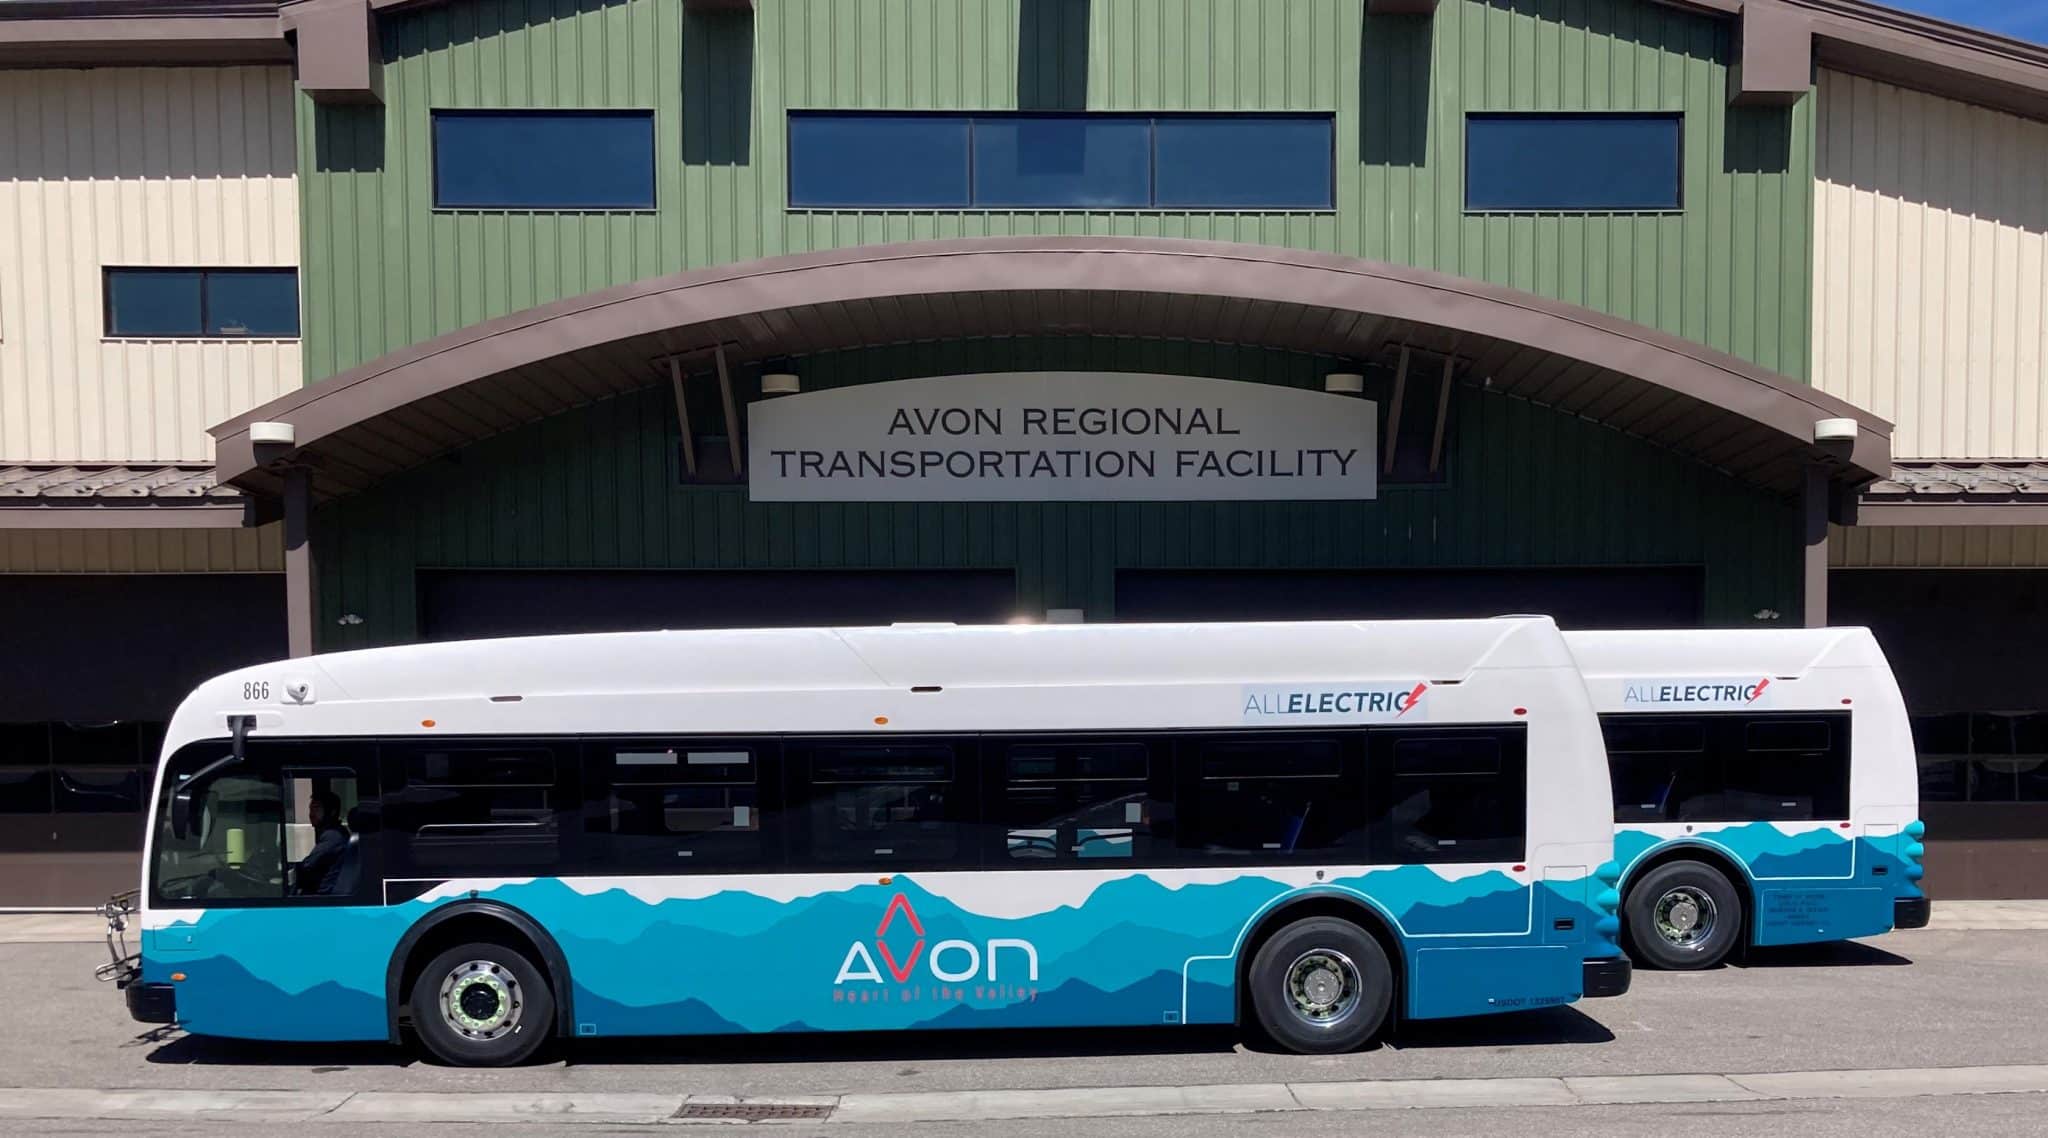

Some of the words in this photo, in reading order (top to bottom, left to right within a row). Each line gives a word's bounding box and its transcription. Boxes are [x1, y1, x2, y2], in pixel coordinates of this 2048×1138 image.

[888, 408, 1002, 435] AVON
[1023, 407, 1240, 436] REGIONAL
[771, 450, 1155, 478] TRANSPORTATION
[1175, 449, 1358, 477] FACILITY
[244, 681, 269, 700] 866
[901, 984, 921, 1003] of
[932, 985, 964, 1002] the
[975, 984, 1039, 1002] Valley
